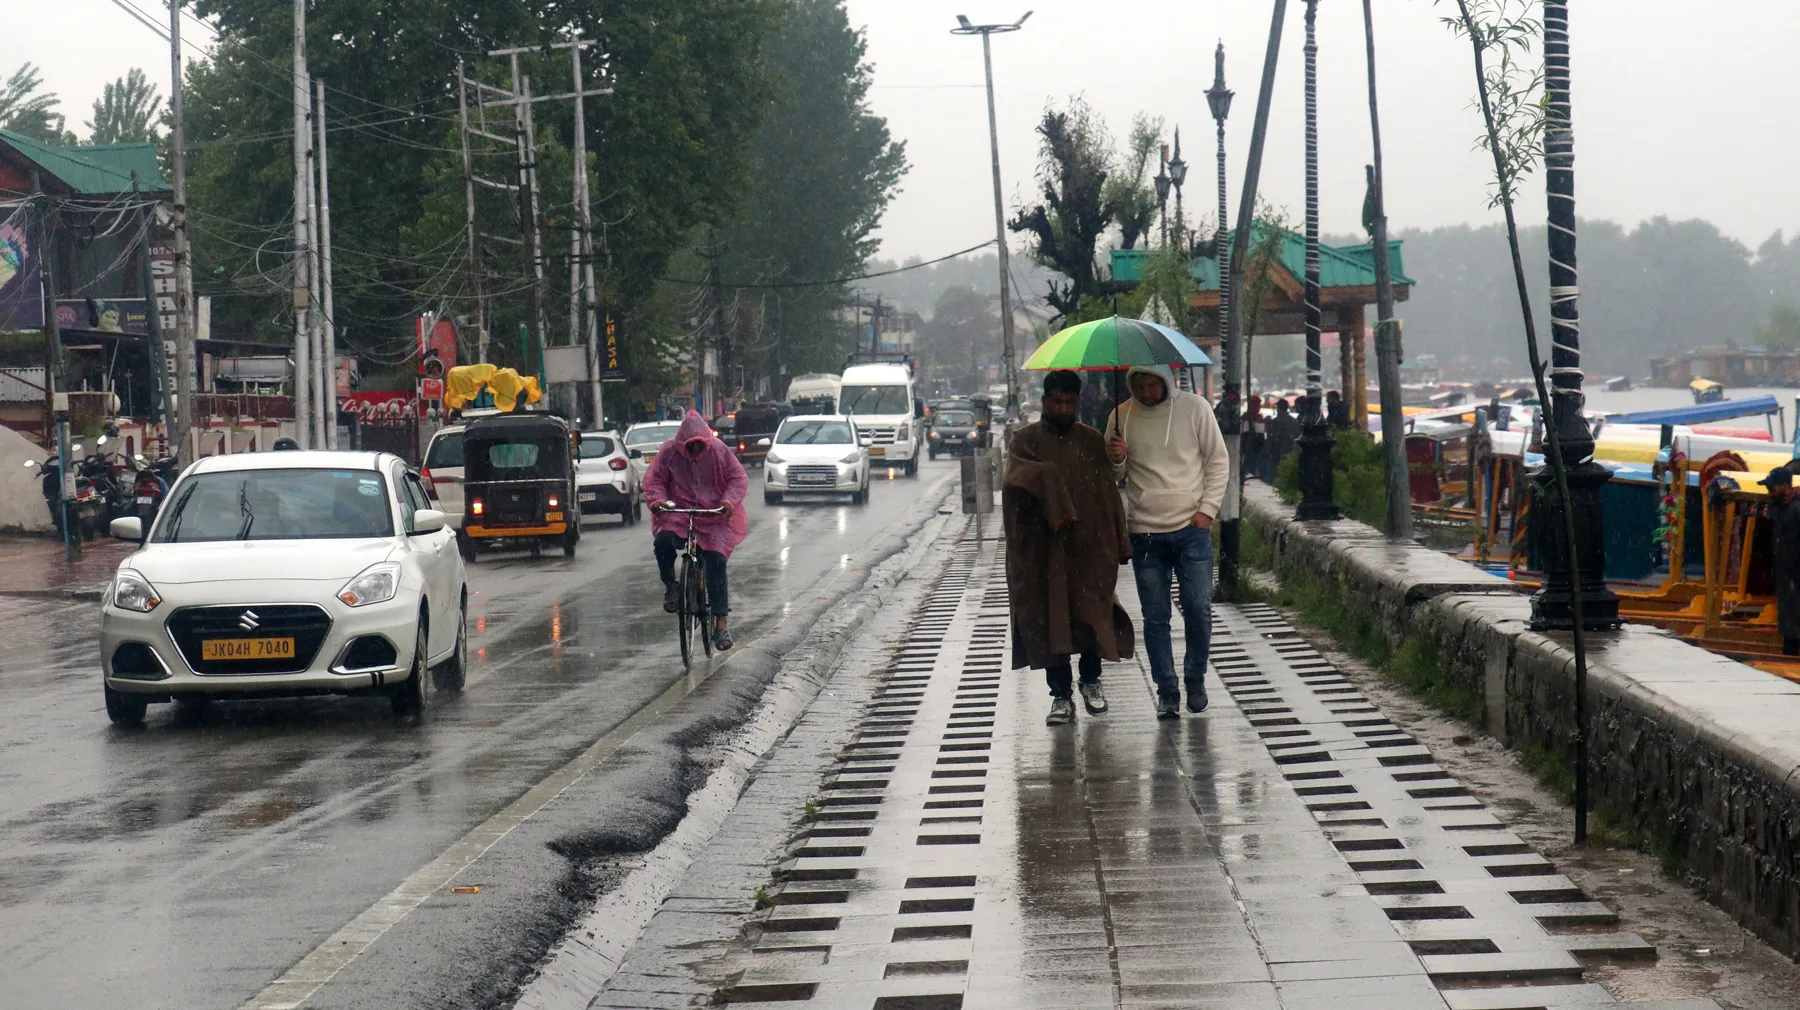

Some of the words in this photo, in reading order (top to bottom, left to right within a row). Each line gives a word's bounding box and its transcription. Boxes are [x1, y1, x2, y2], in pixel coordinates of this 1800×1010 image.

[56, 312, 75, 322] SPA
[606, 313, 617, 369] LHASA
[211, 643, 250, 657] JK04H
[257, 640, 289, 655] 7040
